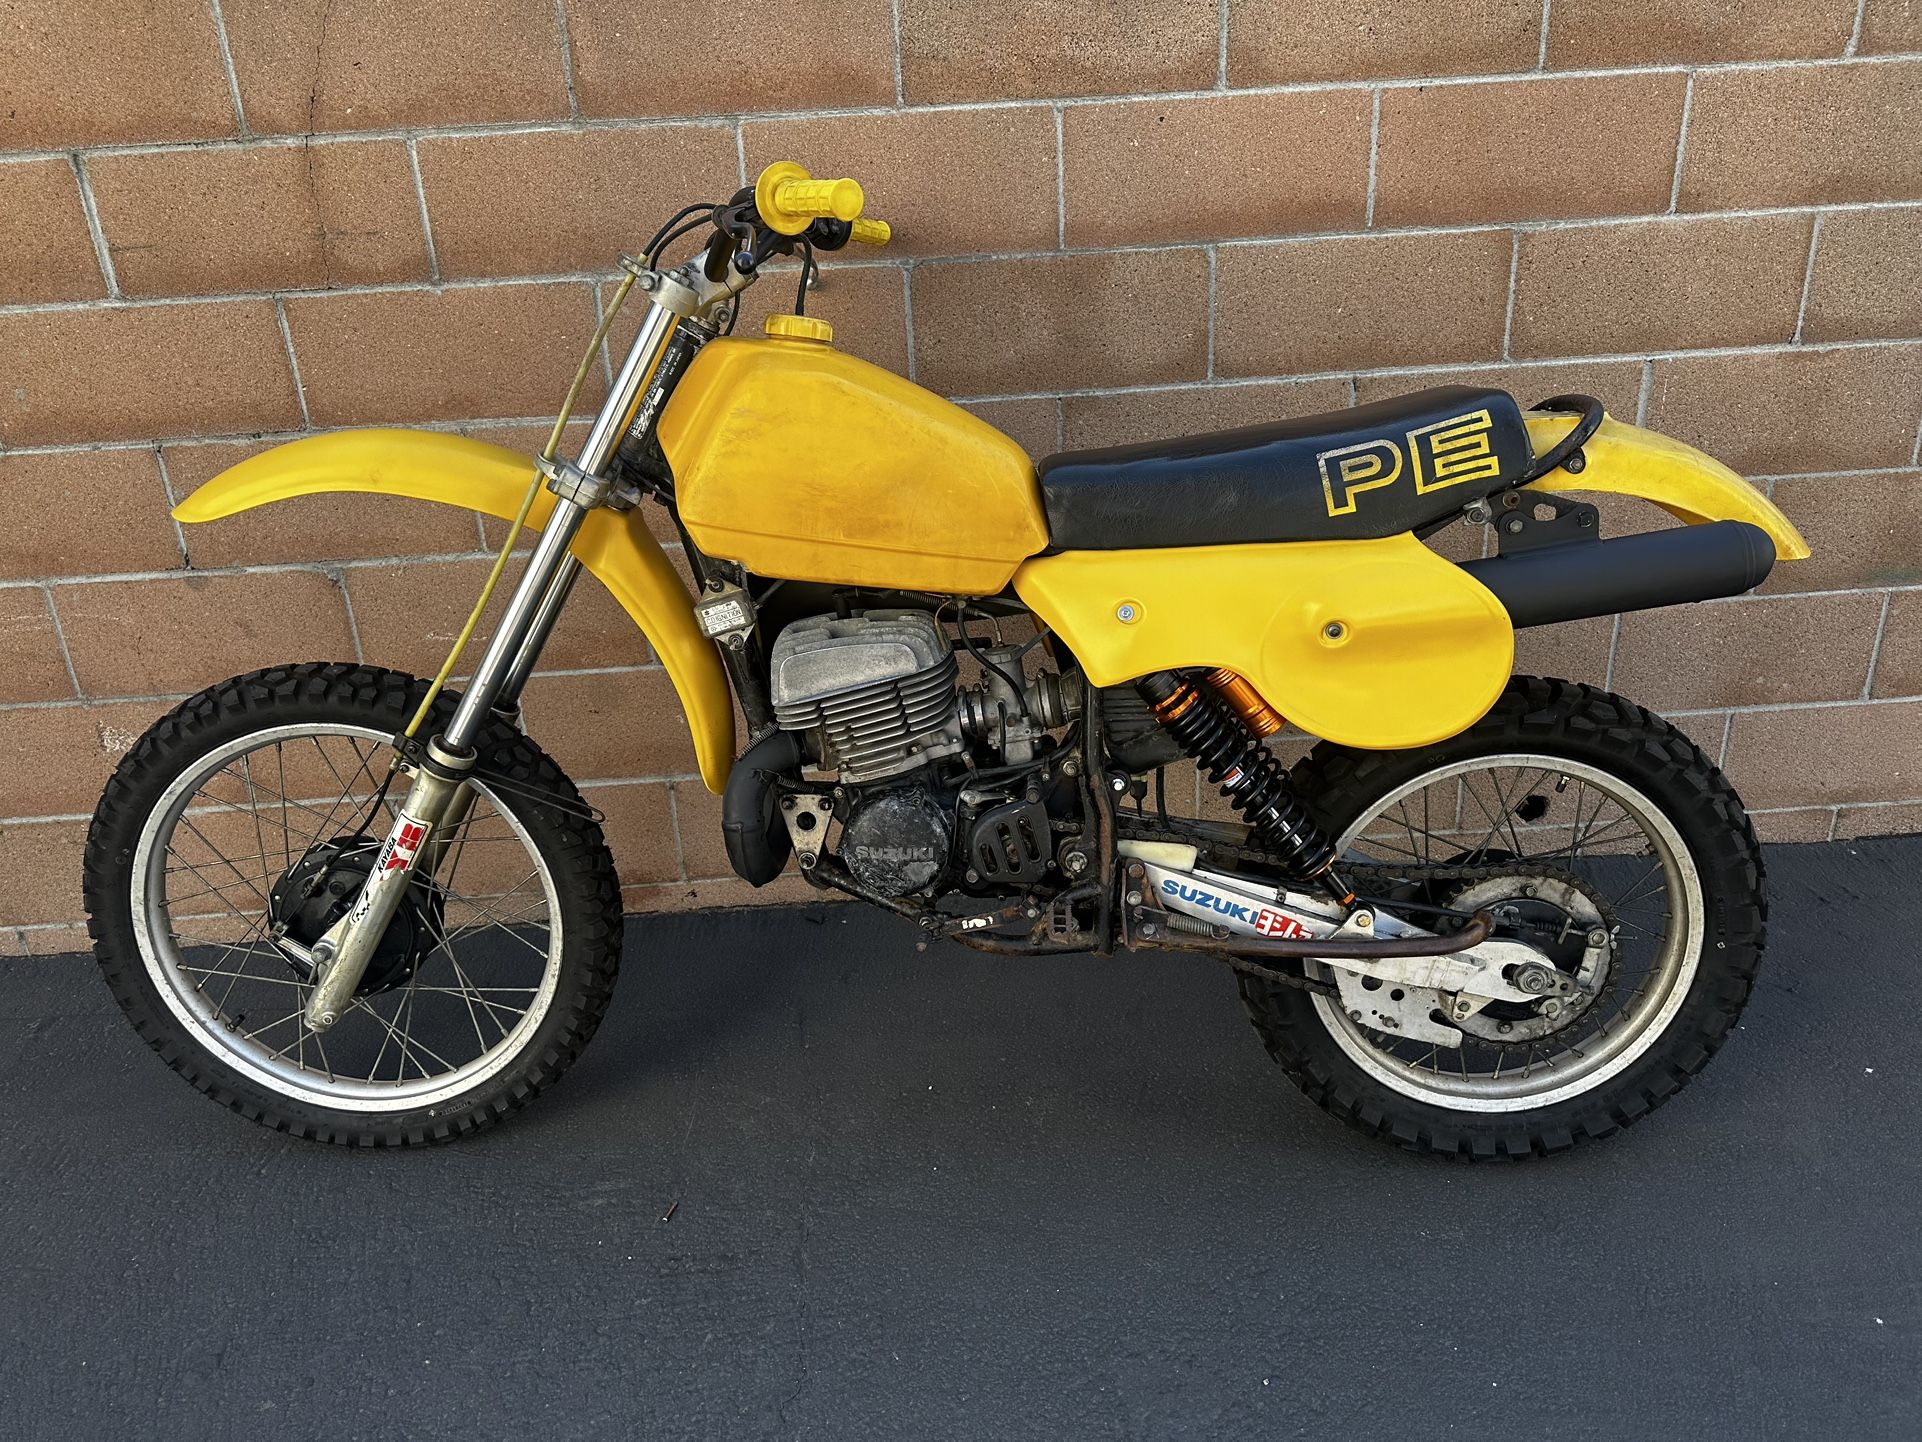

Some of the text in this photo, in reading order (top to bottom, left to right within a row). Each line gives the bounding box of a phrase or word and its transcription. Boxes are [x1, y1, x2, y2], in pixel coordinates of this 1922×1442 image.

[1316, 408, 1500, 517] PE
[377, 836, 397, 873] KAYABA
[855, 845, 934, 861] SUZUKI
[1161, 879, 1260, 925] SUZUKI
